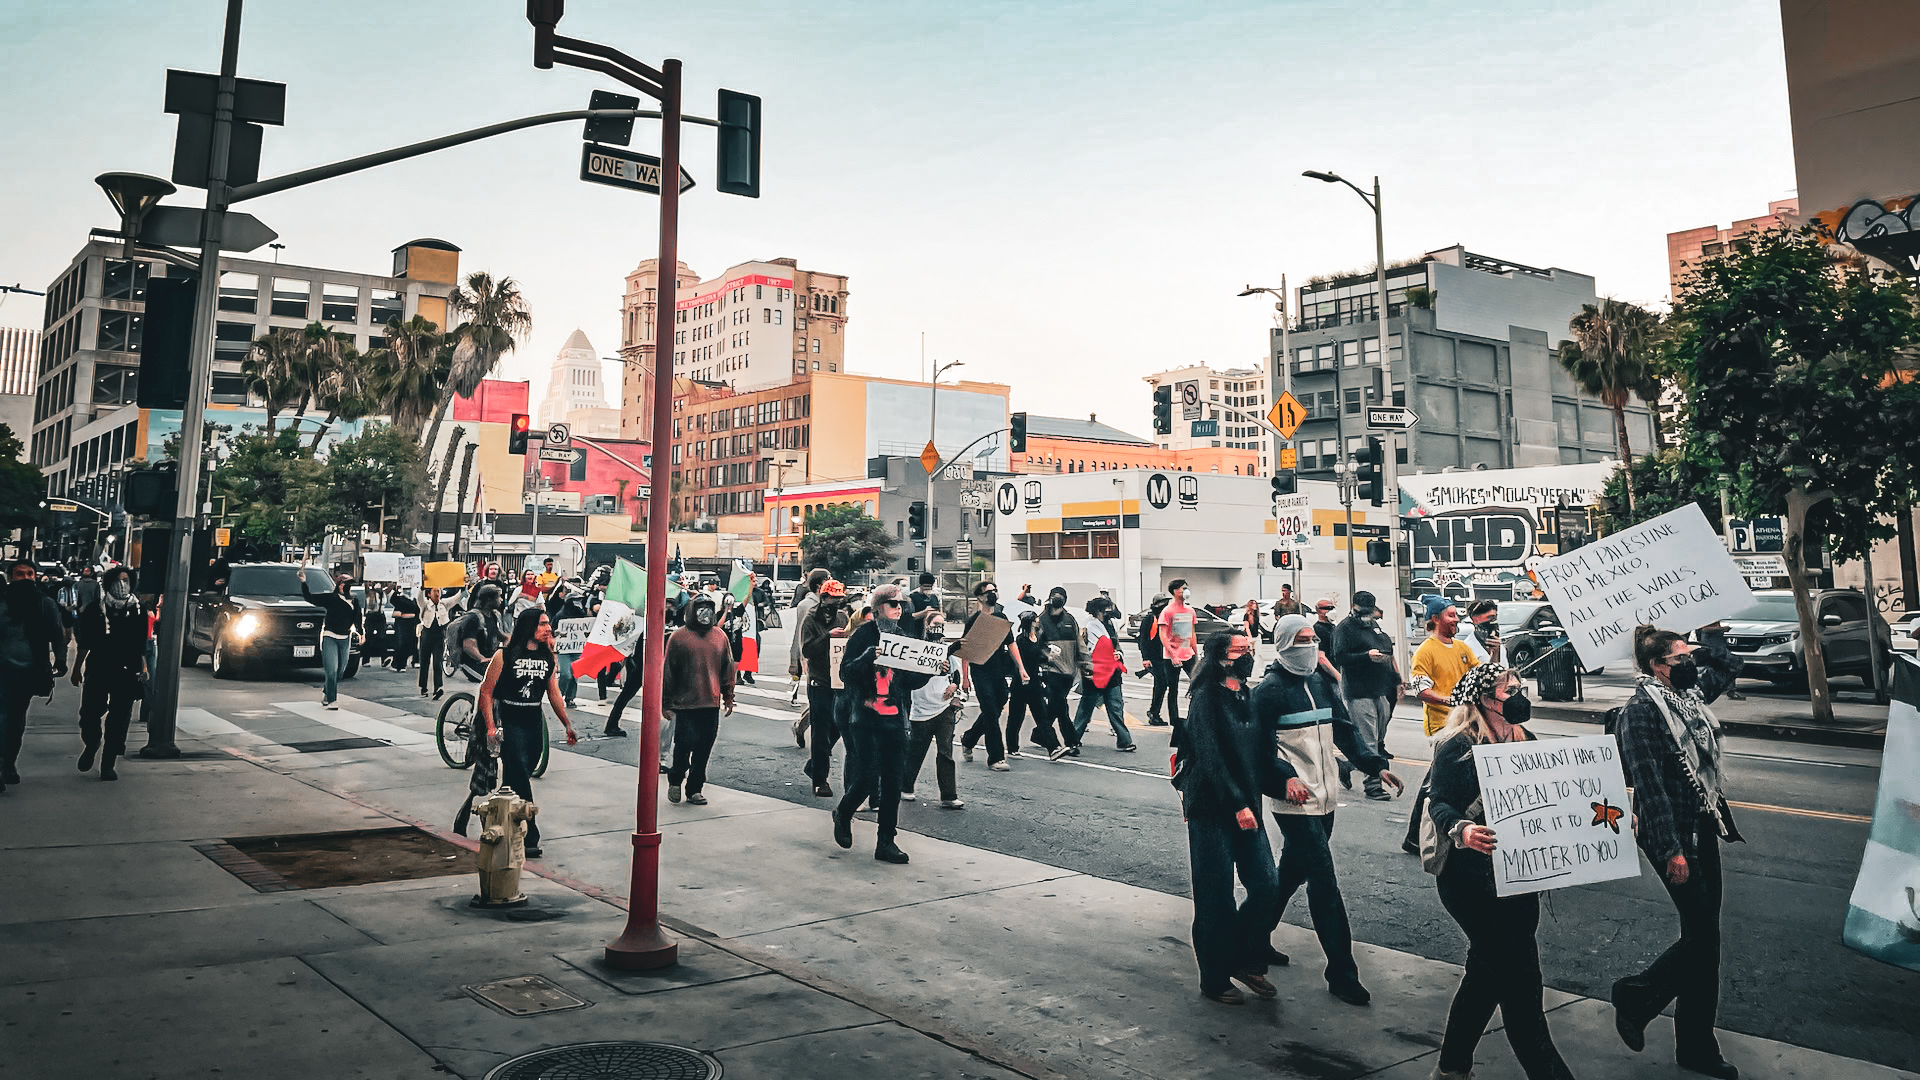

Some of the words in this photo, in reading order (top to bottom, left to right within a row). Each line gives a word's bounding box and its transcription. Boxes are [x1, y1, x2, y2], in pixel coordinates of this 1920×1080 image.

[591, 156, 624, 176] ONE
[635, 164, 660, 184] WA
[1196, 424, 1212, 433] Hill
[1372, 413, 1387, 421] ONE
[1389, 414, 1404, 422] WAY
[1000, 487, 1015, 511] M
[1149, 479, 1169, 504] M
[1735, 529, 1747, 549] P
[1537, 555, 1591, 589] FROM
[1592, 522, 1680, 565] PALESTINE
[1562, 584, 1582, 602] TO
[1585, 556, 1650, 591] MEXICO,
[1568, 606, 1600, 627] ALL
[1601, 588, 1637, 610] THE
[1637, 565, 1697, 595] WALLS
[1588, 617, 1630, 648] HAVE
[1634, 601, 1669, 625] GOT
[1668, 592, 1688, 610] TO
[1688, 579, 1719, 604] GO!
[570, 632, 578, 641] IS
[880, 639, 909, 661] ICE
[922, 645, 944, 657] NEO
[1481, 756, 1503, 778] IT
[1572, 747, 1597, 767] HAVE
[1598, 746, 1613, 762] TO
[1485, 783, 1548, 821] HAPPEN
[1551, 780, 1570, 800] TO
[1572, 777, 1602, 798] YOU
[1520, 817, 1546, 838] FOR
[1551, 815, 1563, 831] IT
[1568, 814, 1582, 828] TO
[1502, 845, 1572, 881] MATTER
[1573, 842, 1590, 865] TO
[1591, 839, 1618, 864] YOU
